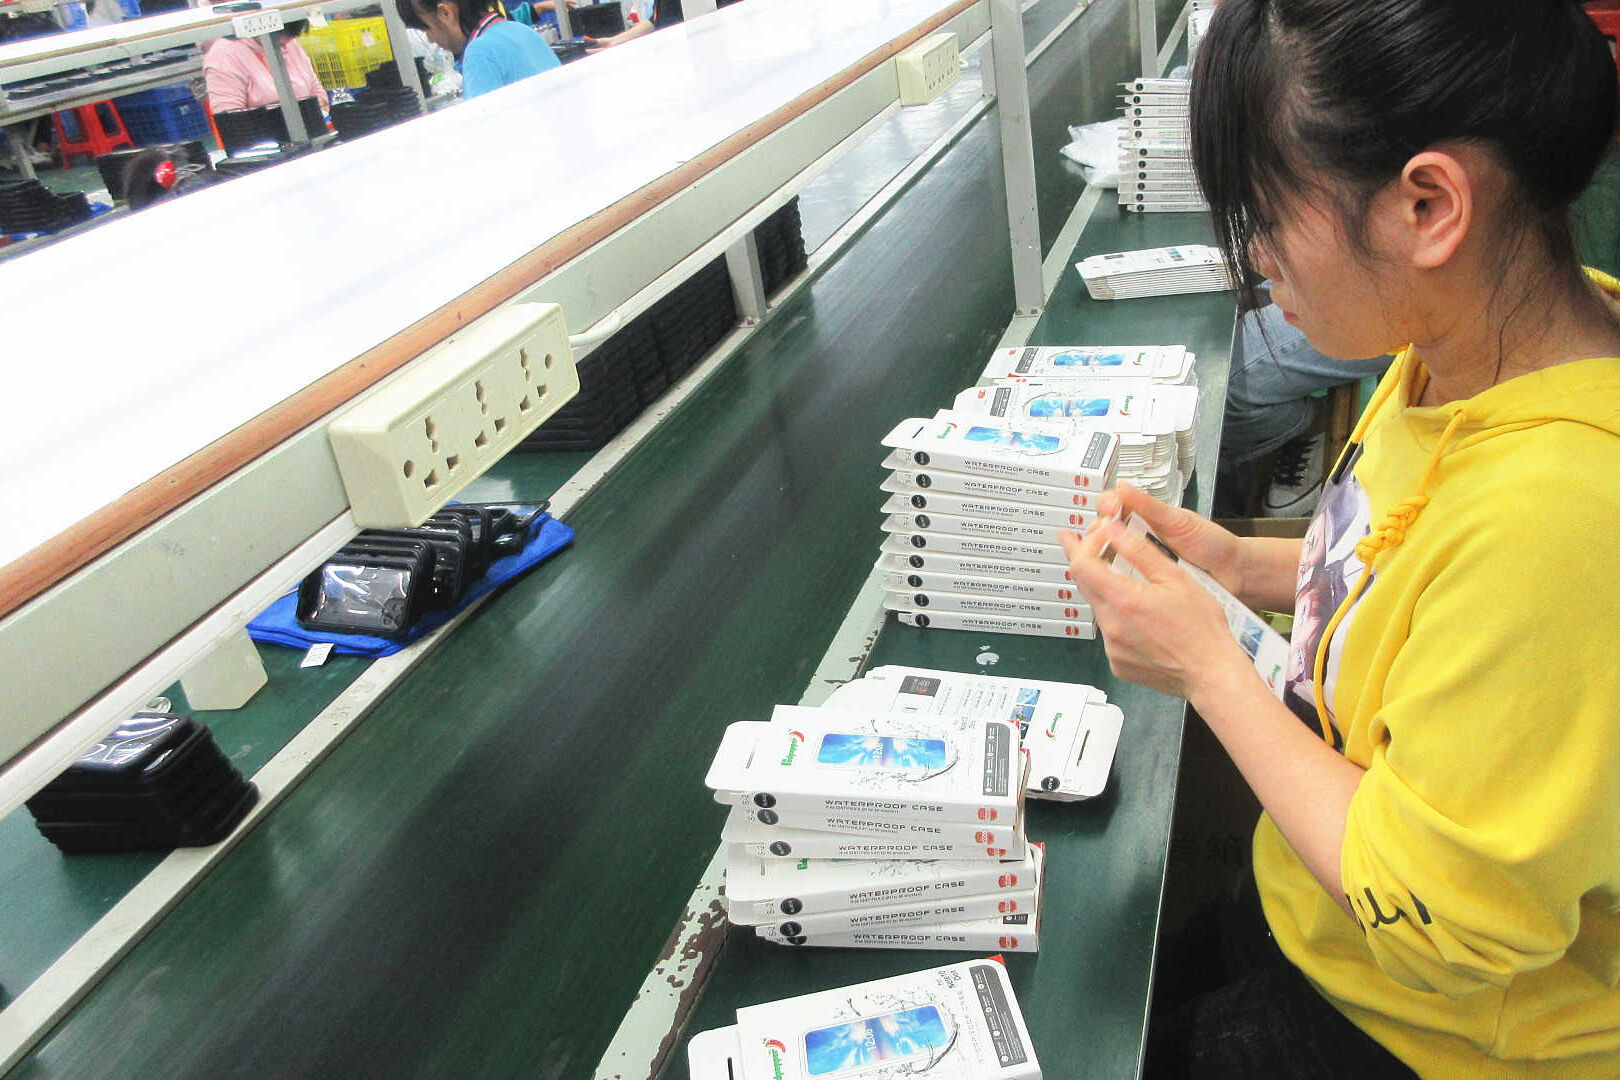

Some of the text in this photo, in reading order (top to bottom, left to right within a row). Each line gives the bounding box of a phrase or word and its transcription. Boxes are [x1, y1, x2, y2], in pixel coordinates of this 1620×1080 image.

[1027, 469, 1050, 477] CASE
[825, 800, 944, 812] WATERPROOF CASE
[826, 818, 906, 830] WATERPROOF
[910, 826, 942, 834] CASE
[850, 884, 930, 899] WATERPROOF
[934, 880, 966, 888] CASE
[850, 910, 930, 923] WATERPROOF
[934, 906, 966, 915] CASE
[853, 934, 931, 942] WATERPROOF
